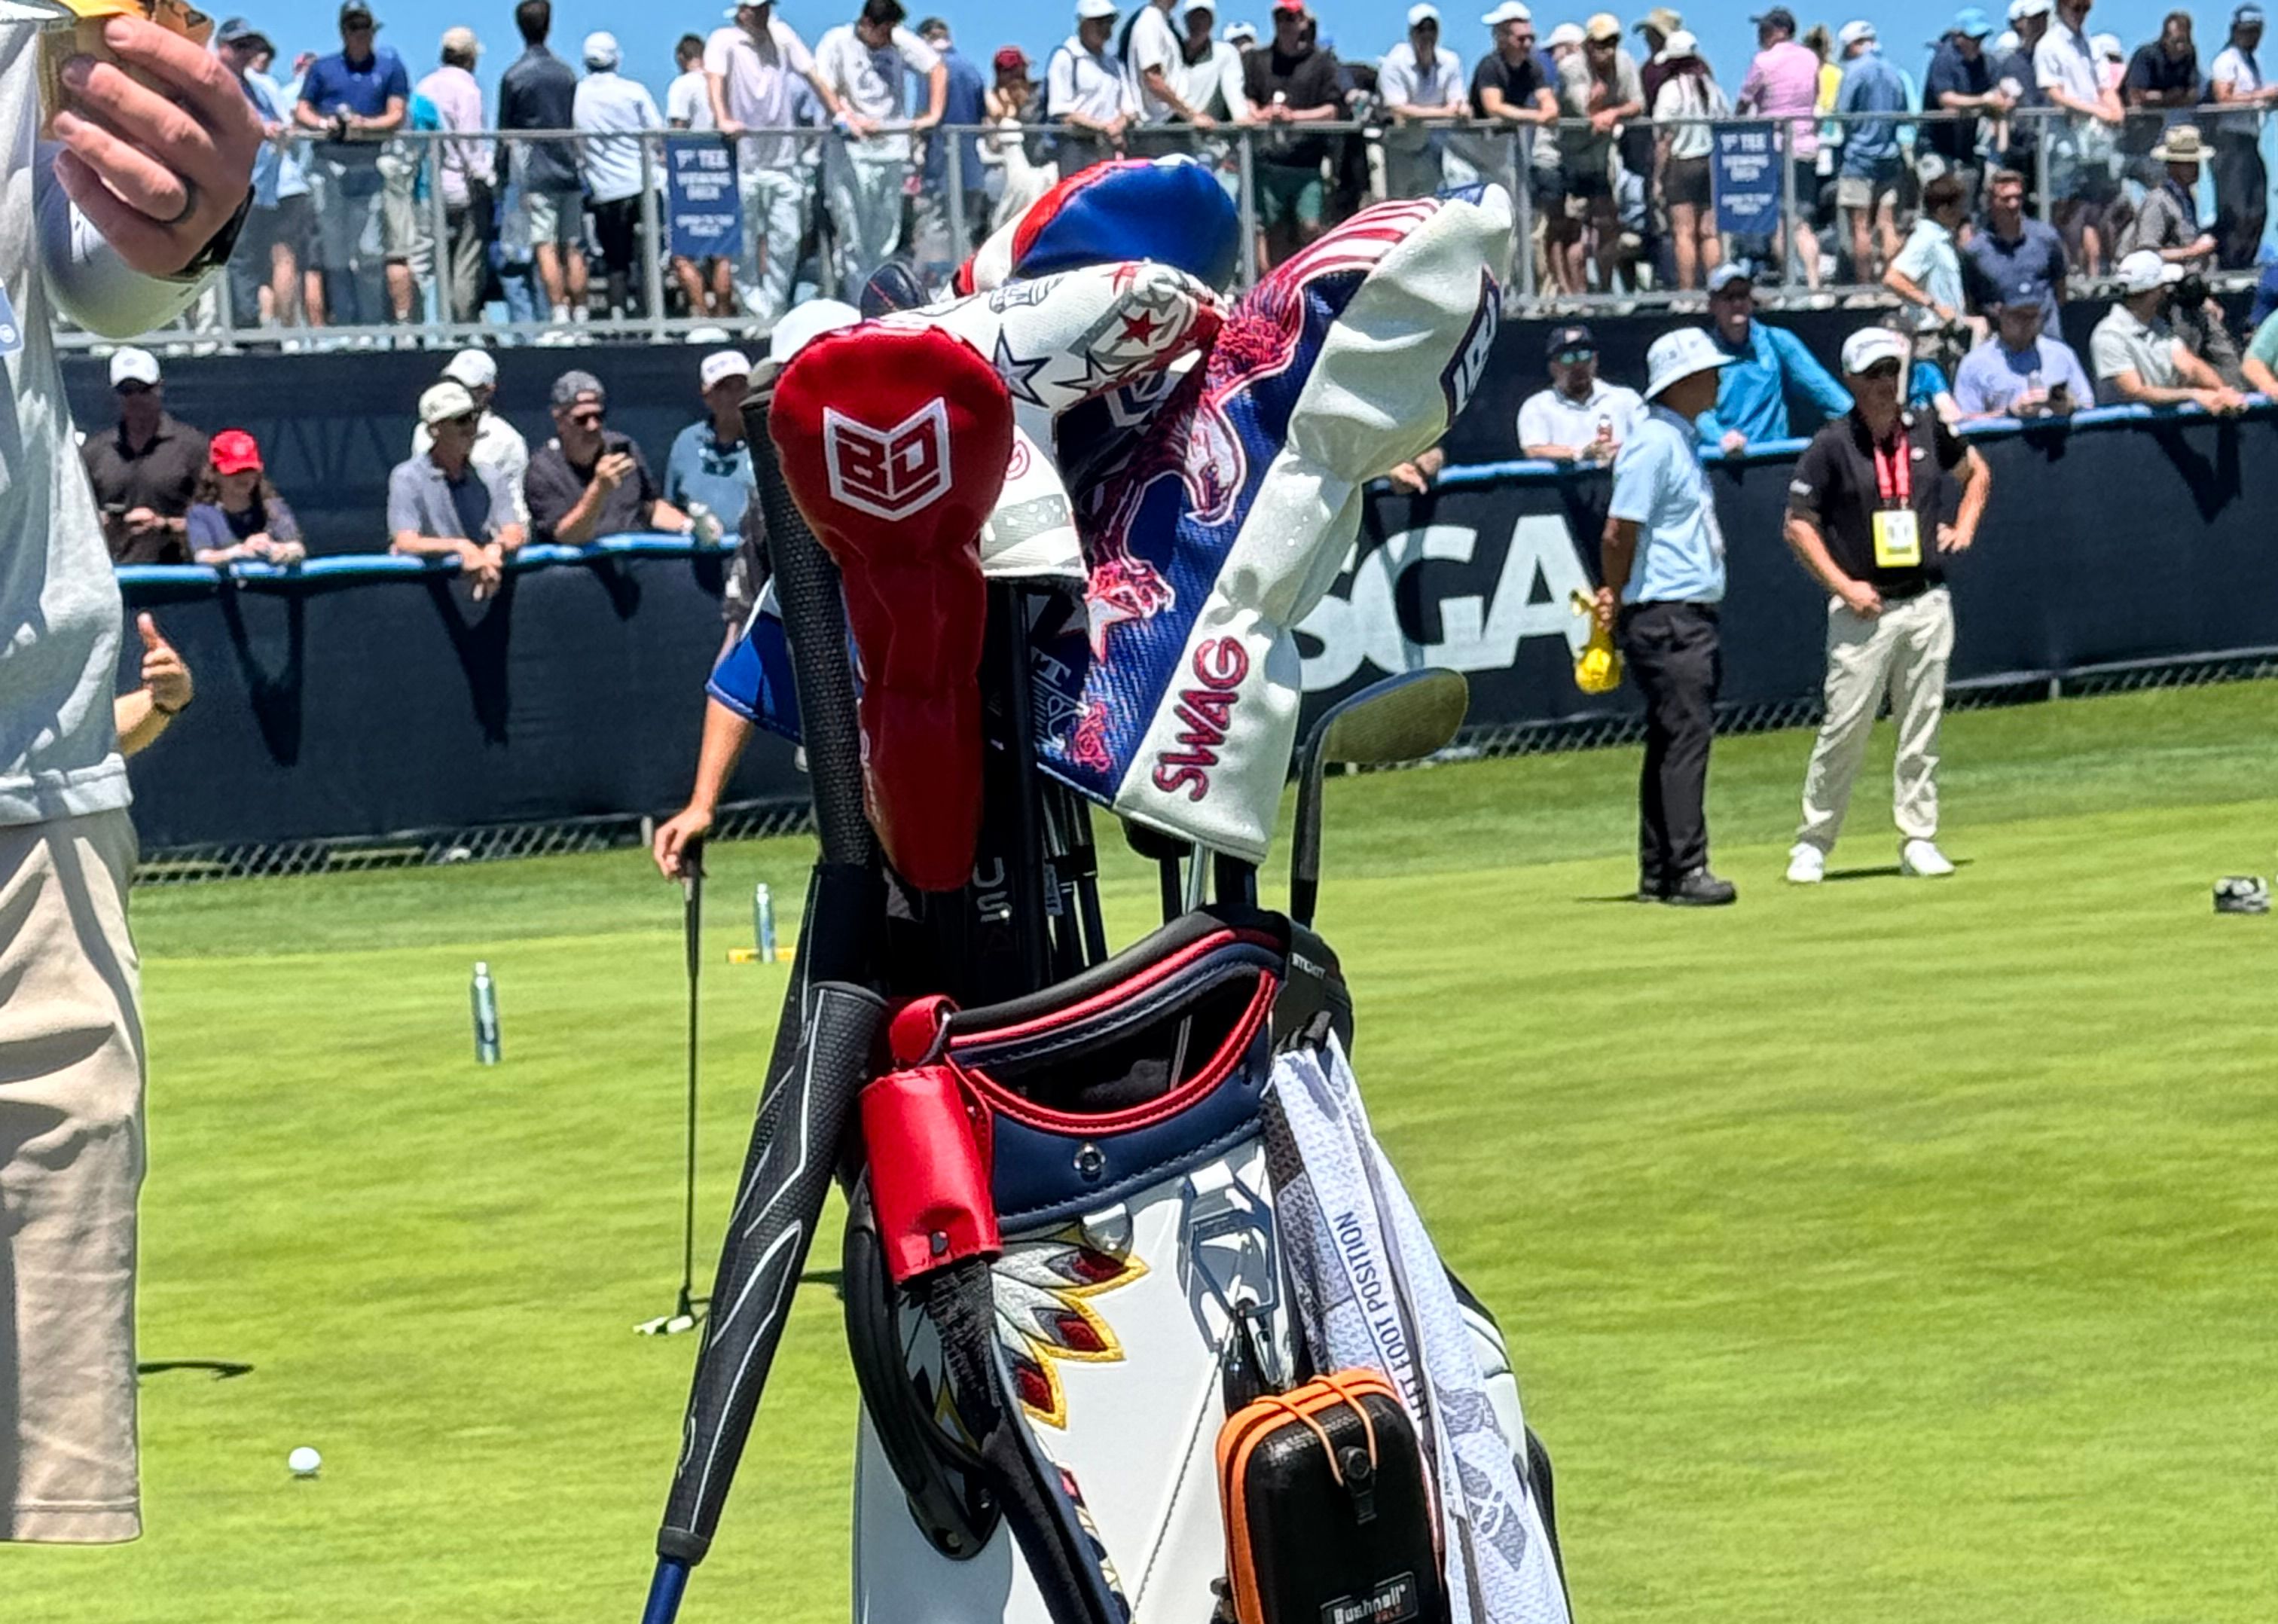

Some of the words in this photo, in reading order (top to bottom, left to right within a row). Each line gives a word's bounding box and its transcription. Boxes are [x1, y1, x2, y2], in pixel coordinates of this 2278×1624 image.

[1152, 635, 1250, 802] SWAG
[1333, 1210, 1389, 1314] POSITION
[1373, 1317, 1412, 1372] FOOT
